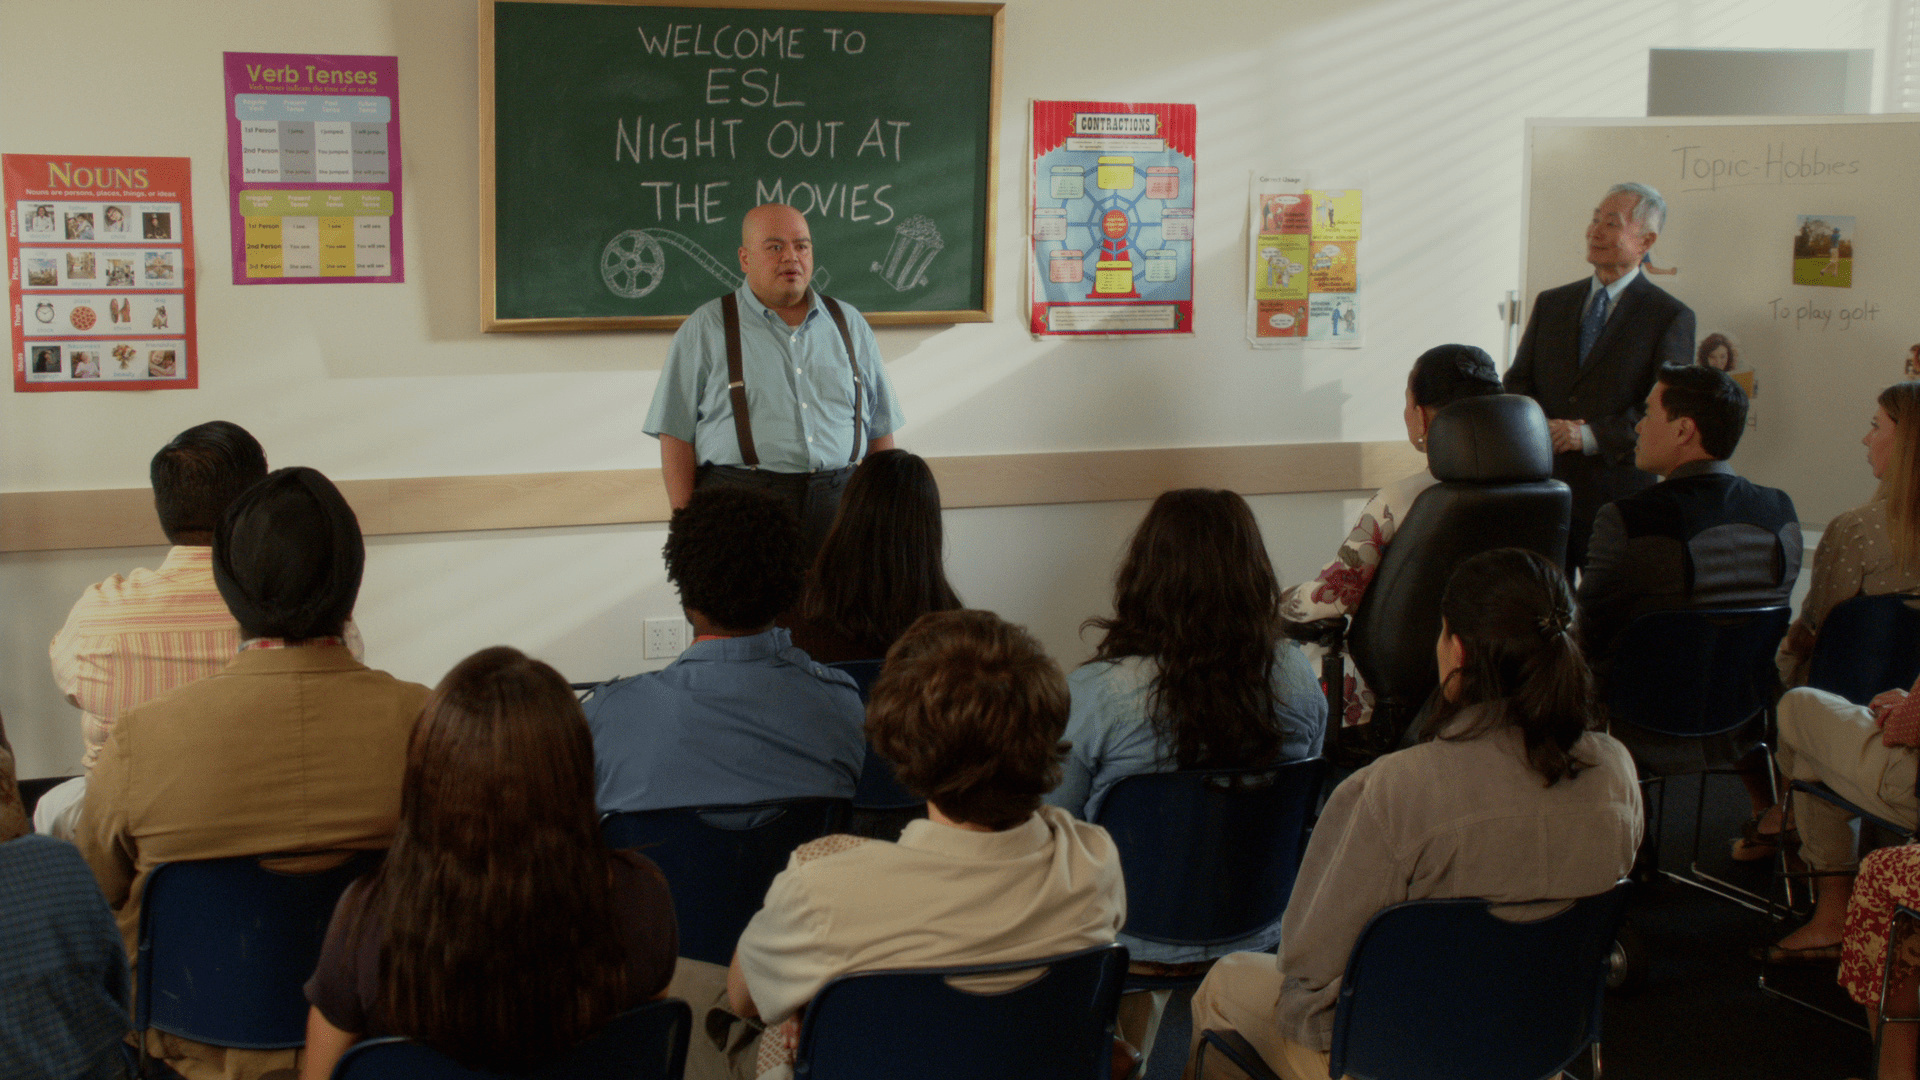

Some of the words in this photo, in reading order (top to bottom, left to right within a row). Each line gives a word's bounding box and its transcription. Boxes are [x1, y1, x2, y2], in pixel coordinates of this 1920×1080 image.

[637, 23, 804, 59] WELCOME
[823, 28, 866, 55] TO
[246, 64, 300, 83] Verb
[305, 65, 378, 85] Tenses
[705, 68, 805, 107] ESL
[615, 115, 743, 163] NIGHT
[767, 120, 844, 158] OUT
[856, 118, 911, 161] AT
[1081, 116, 1151, 131] CONTRACTIONS
[26, 188, 50, 196] Nouns
[96, 190, 122, 198] places,
[640, 181, 730, 224] THE
[756, 177, 894, 225] MOVIES
[1767, 297, 1790, 320] To
[1796, 300, 1832, 333] play
